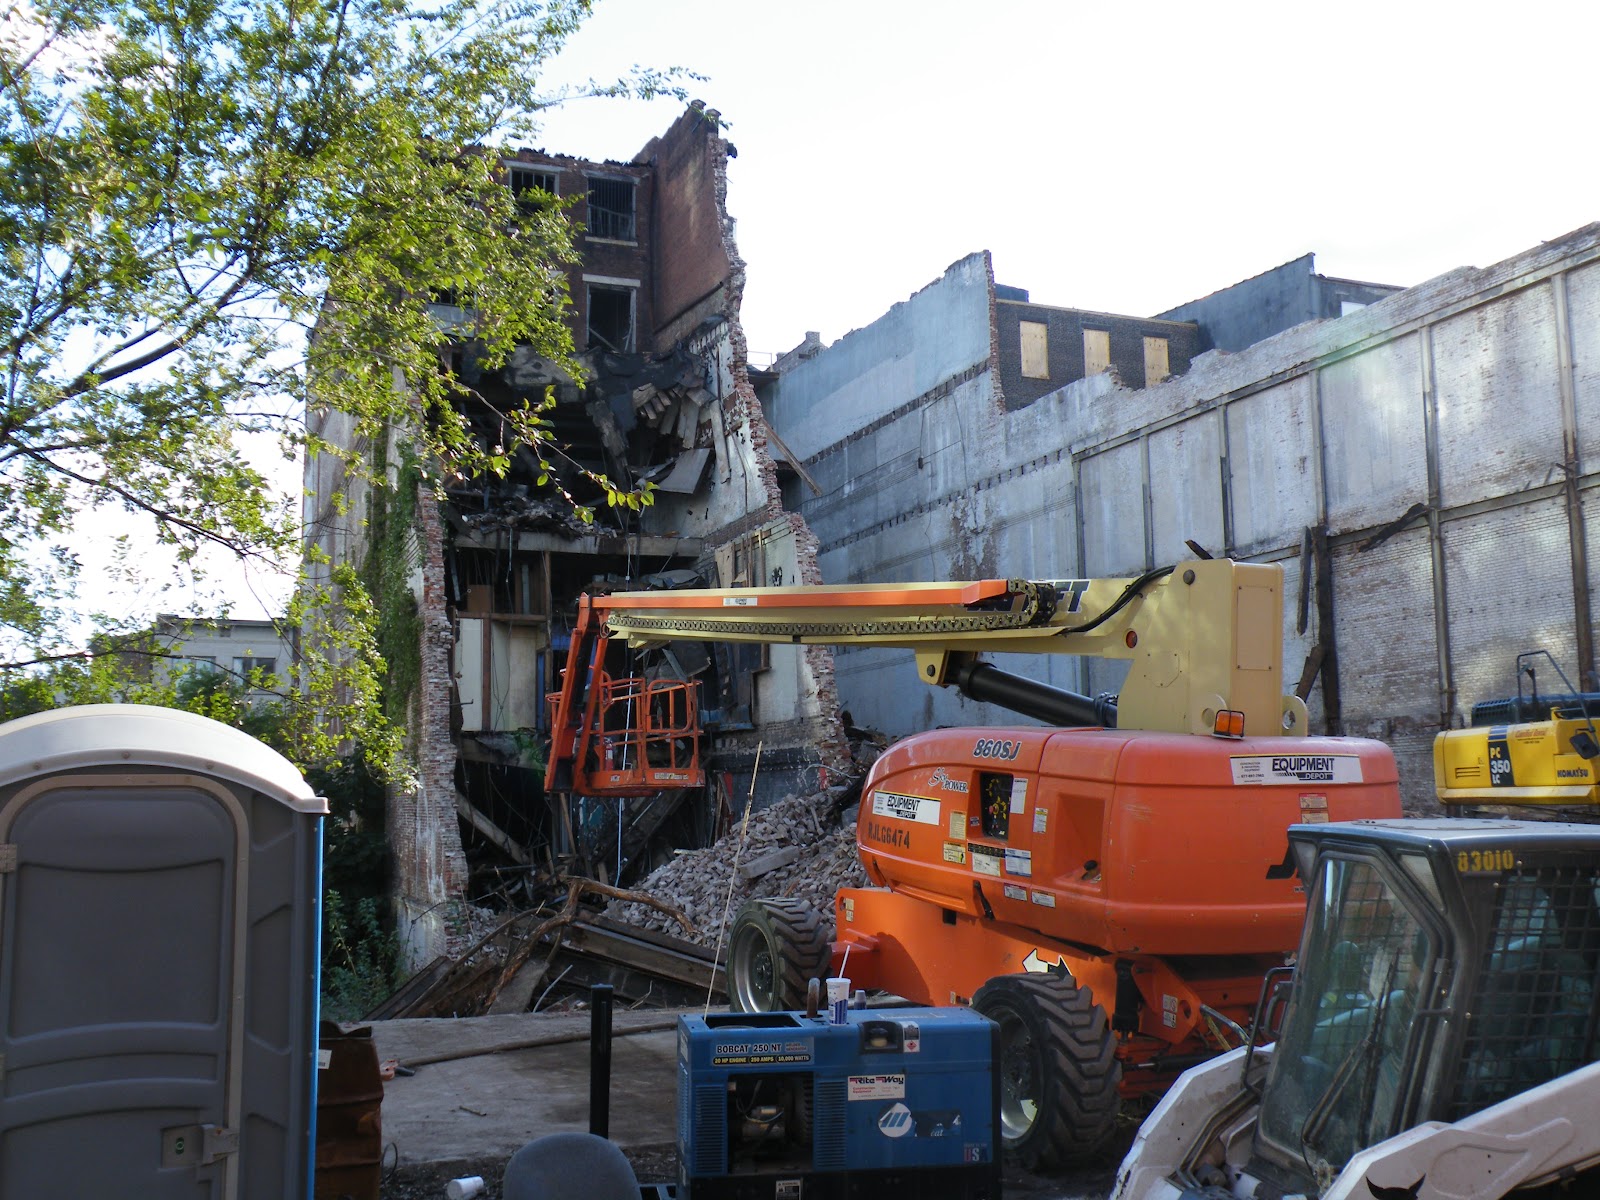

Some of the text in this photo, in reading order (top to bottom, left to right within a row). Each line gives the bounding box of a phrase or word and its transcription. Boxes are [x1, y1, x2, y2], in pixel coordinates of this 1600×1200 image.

[973, 738, 1021, 760] 860SJ
[1490, 747, 1500, 758] PC
[1272, 758, 1334, 772] EQUIPMENT
[1490, 760, 1510, 774] 350
[1492, 774, 1500, 784] LC
[1557, 767, 1588, 778] KOMATSU
[942, 779, 969, 793] POWER
[887, 796, 920, 811] EQUIPMENT
[900, 811, 915, 819] DEPOT
[1457, 850, 1514, 872] 83010
[717, 1043, 782, 1054] BOBCAT 250 NT
[876, 1076, 904, 1084] Way
[964, 1147, 989, 1162] USA
